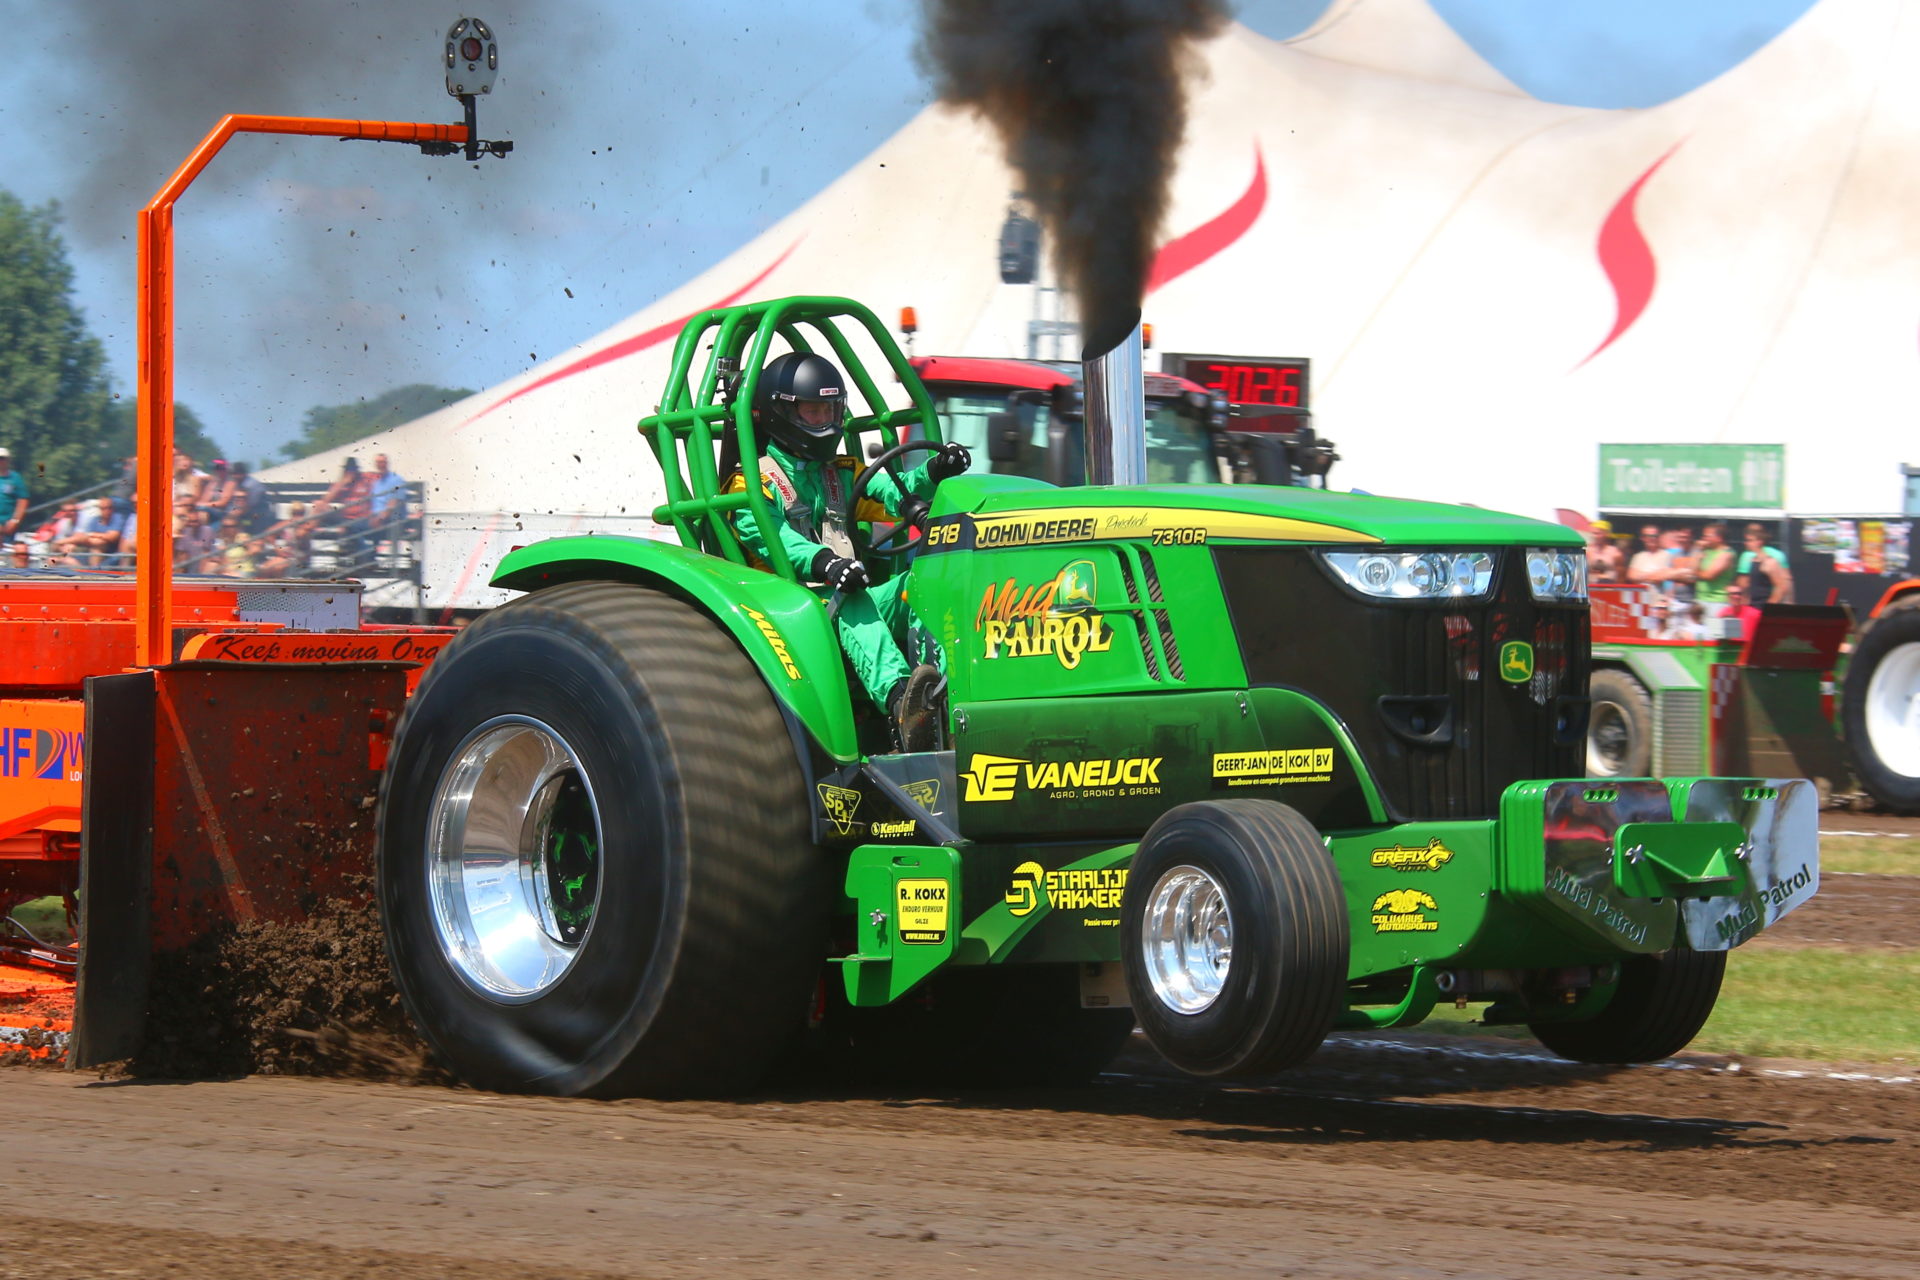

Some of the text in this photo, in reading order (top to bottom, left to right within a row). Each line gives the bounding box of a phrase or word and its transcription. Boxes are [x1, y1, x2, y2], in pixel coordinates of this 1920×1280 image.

[767, 471, 794, 502] SIMPSON
[1607, 457, 1733, 493] Toiletten
[928, 524, 960, 545] 518
[978, 518, 1096, 548] JOHN DEERE
[1152, 528, 1207, 546] 7310R
[975, 570, 1066, 632] Mud
[215, 636, 441, 662] Keep moving Ora
[740, 603, 802, 681] Mitas
[983, 615, 1114, 670] PATROL
[1025, 757, 1163, 789] VANEIJCK
[1216, 754, 1330, 772] GEERT-JAN DE KOK BV
[1050, 790, 1079, 799] AGRO,
[1083, 788, 1115, 798] GROND
[1129, 787, 1161, 796] GROEN
[880, 820, 917, 833] Kendall
[900, 888, 945, 900] R. KOKX
[1047, 888, 1125, 909] VAKWER
[1552, 866, 1648, 945] Mud Patrol
[1715, 863, 1812, 943] Mud Patrol
[1372, 913, 1424, 924] COLUMBUS
[1376, 922, 1438, 933] MOTORSPORTS
